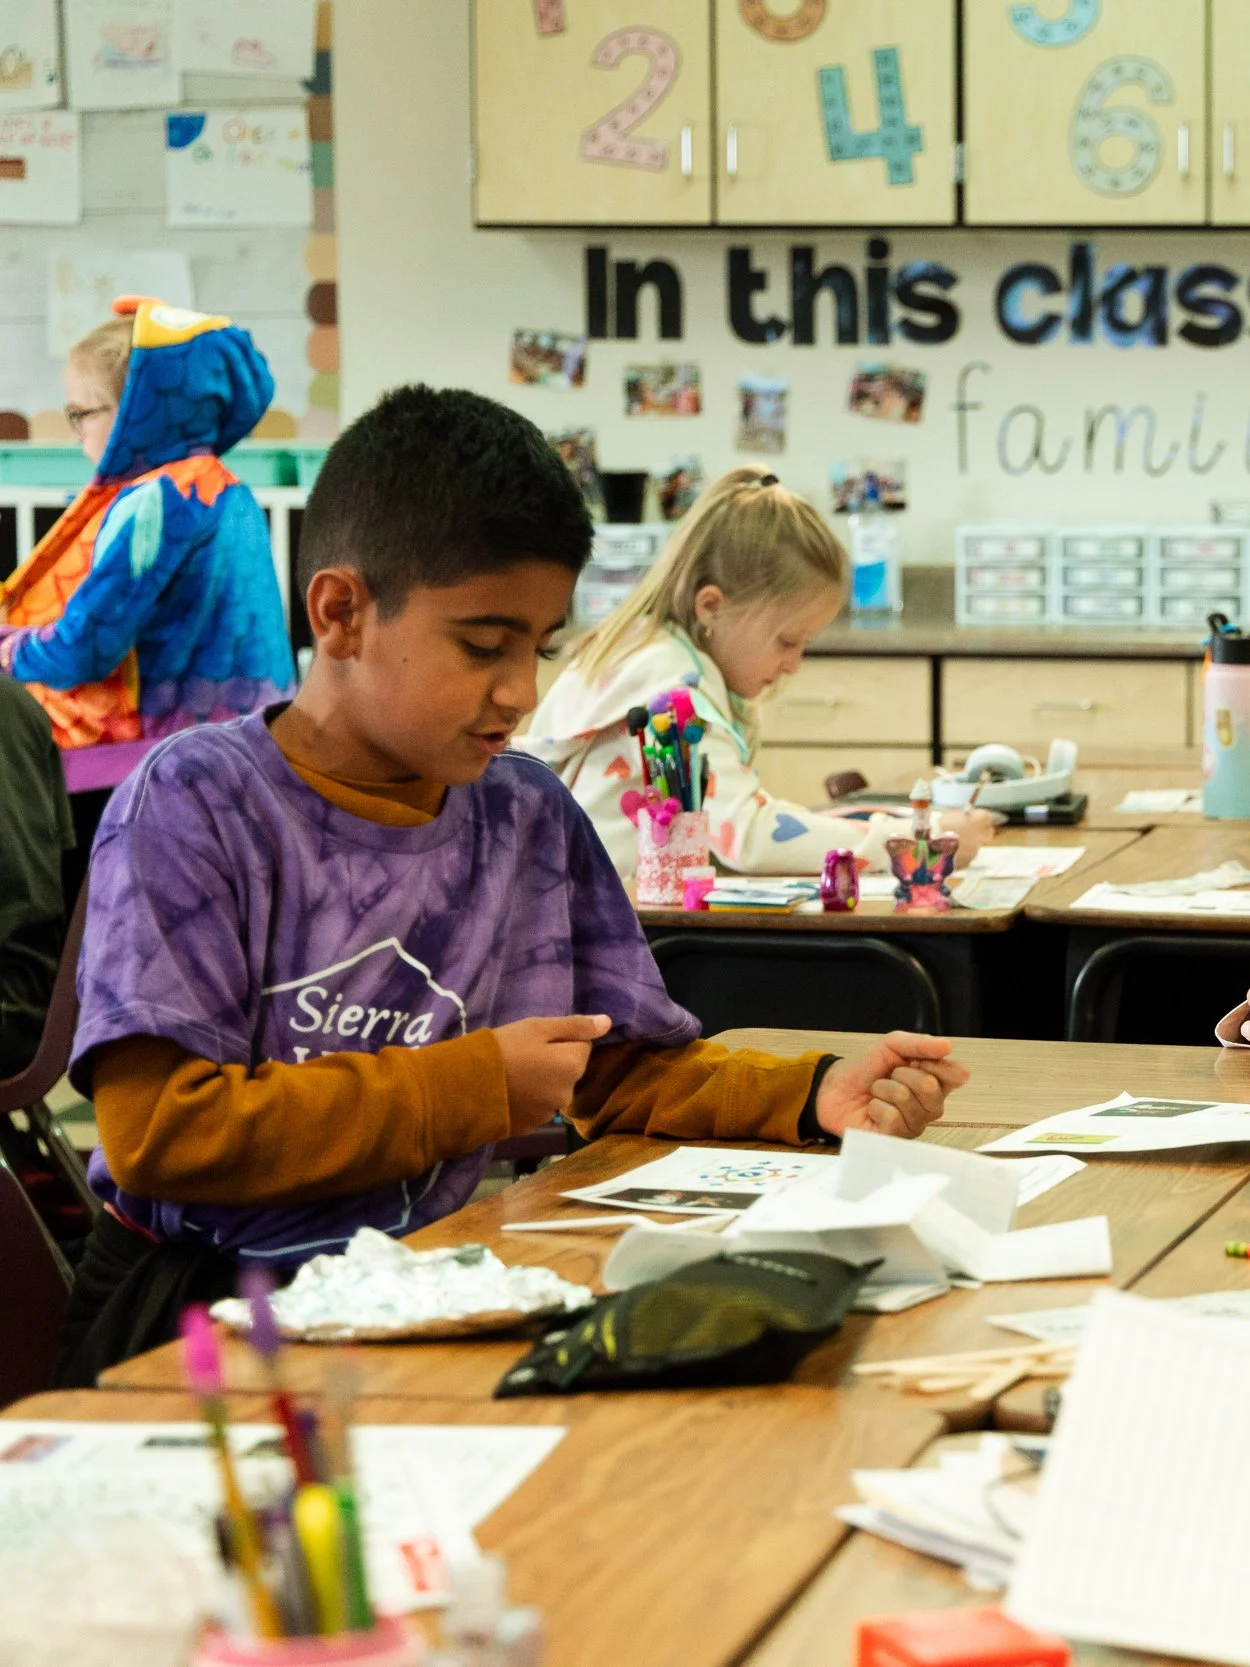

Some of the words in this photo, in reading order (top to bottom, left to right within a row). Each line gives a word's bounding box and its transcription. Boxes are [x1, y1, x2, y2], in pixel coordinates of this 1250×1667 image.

[579, 25, 683, 172] 2
[816, 46, 923, 186] 4
[1071, 54, 1175, 199] 6
[584, 246, 683, 340] In
[726, 237, 961, 346] this
[289, 985, 434, 1044] Sierra
